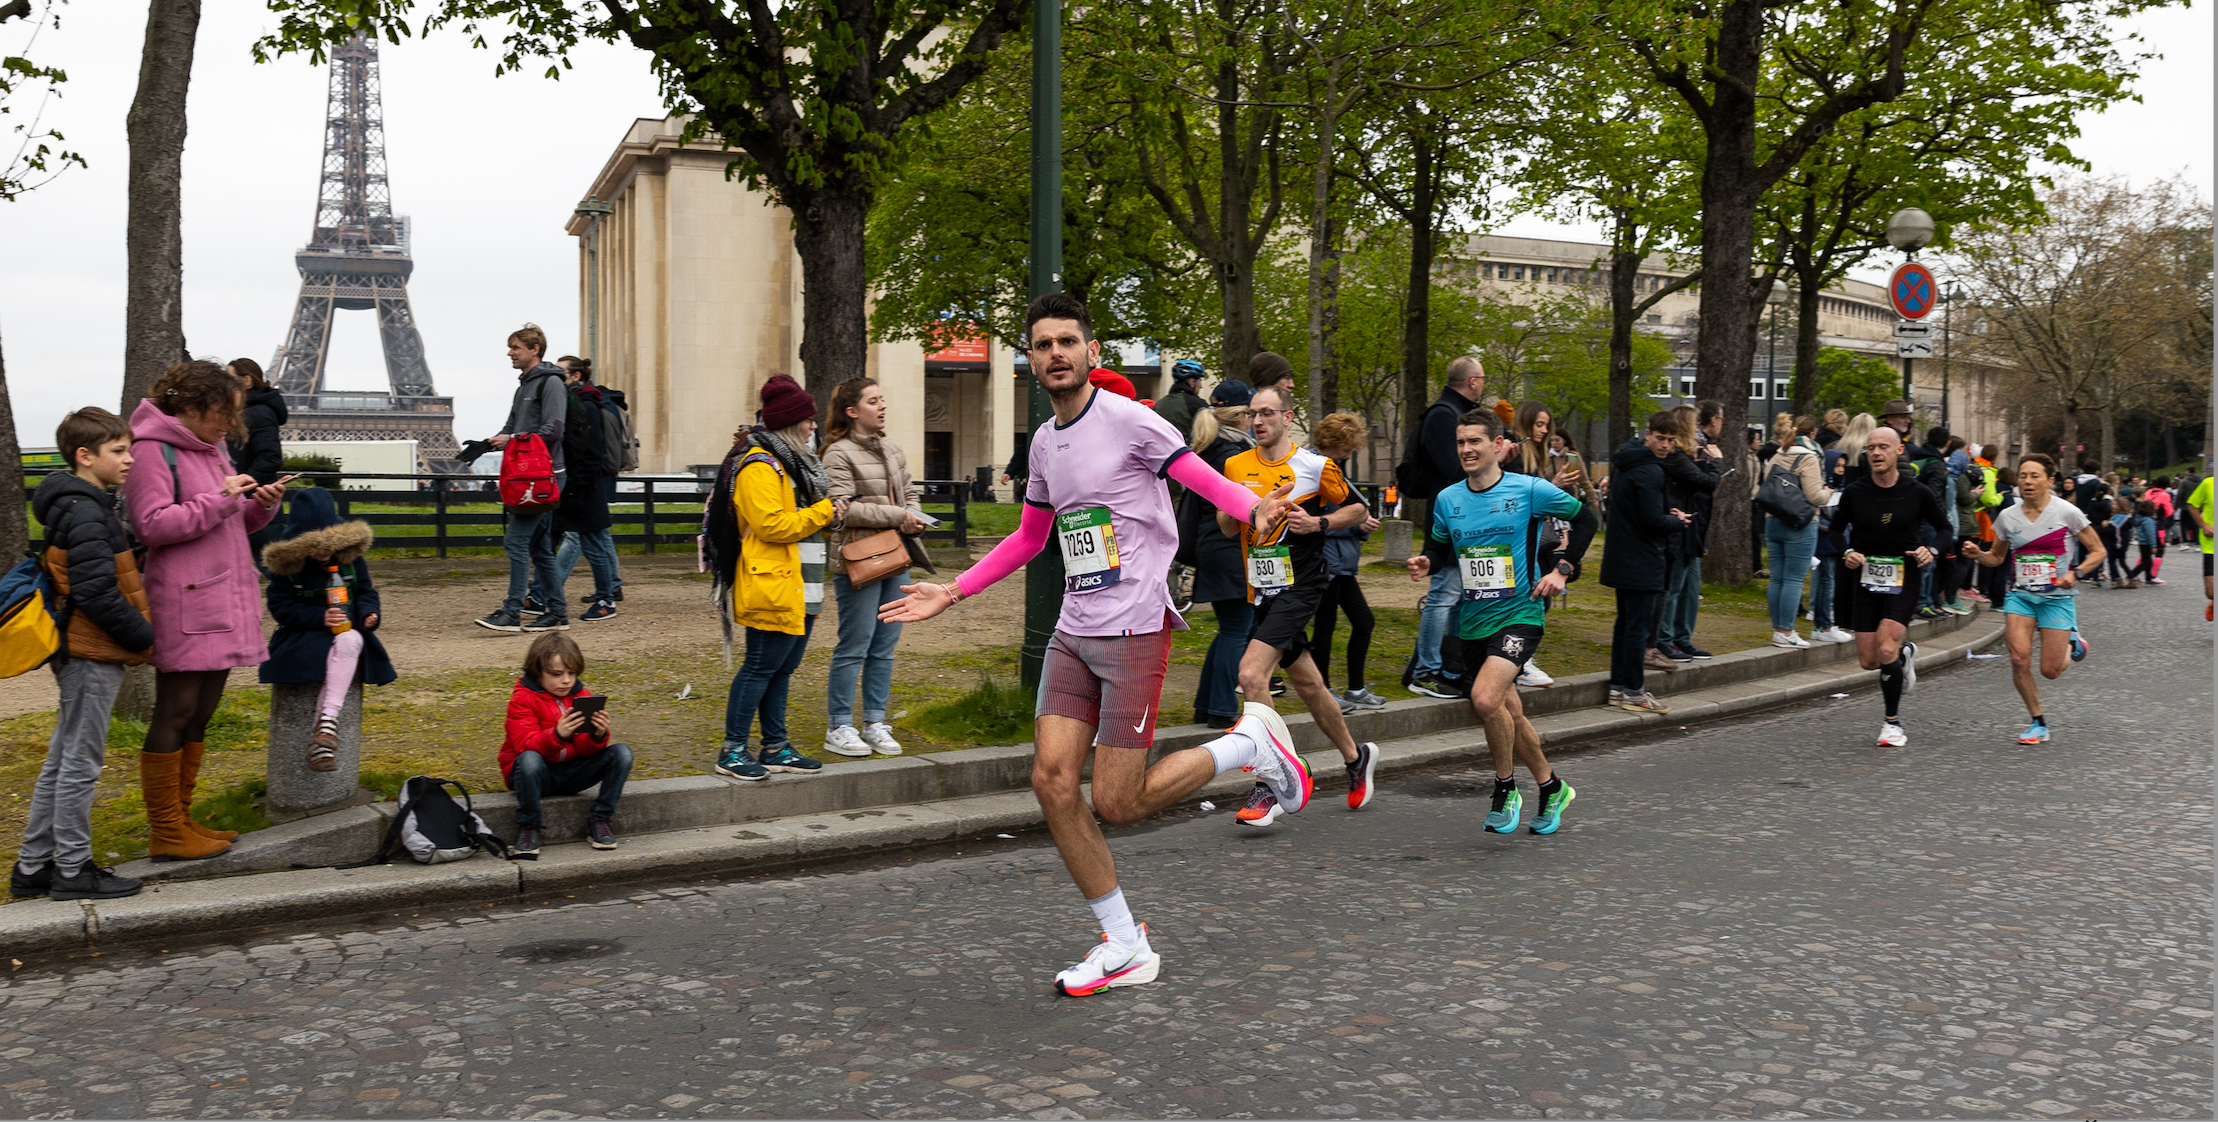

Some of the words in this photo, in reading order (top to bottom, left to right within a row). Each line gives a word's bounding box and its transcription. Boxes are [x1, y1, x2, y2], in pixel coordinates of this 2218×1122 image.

[1062, 513, 1091, 524] Schneider
[1256, 560, 1274, 575] 630
[1470, 560, 1494, 576] 606
[1869, 564, 1892, 577] 6220
